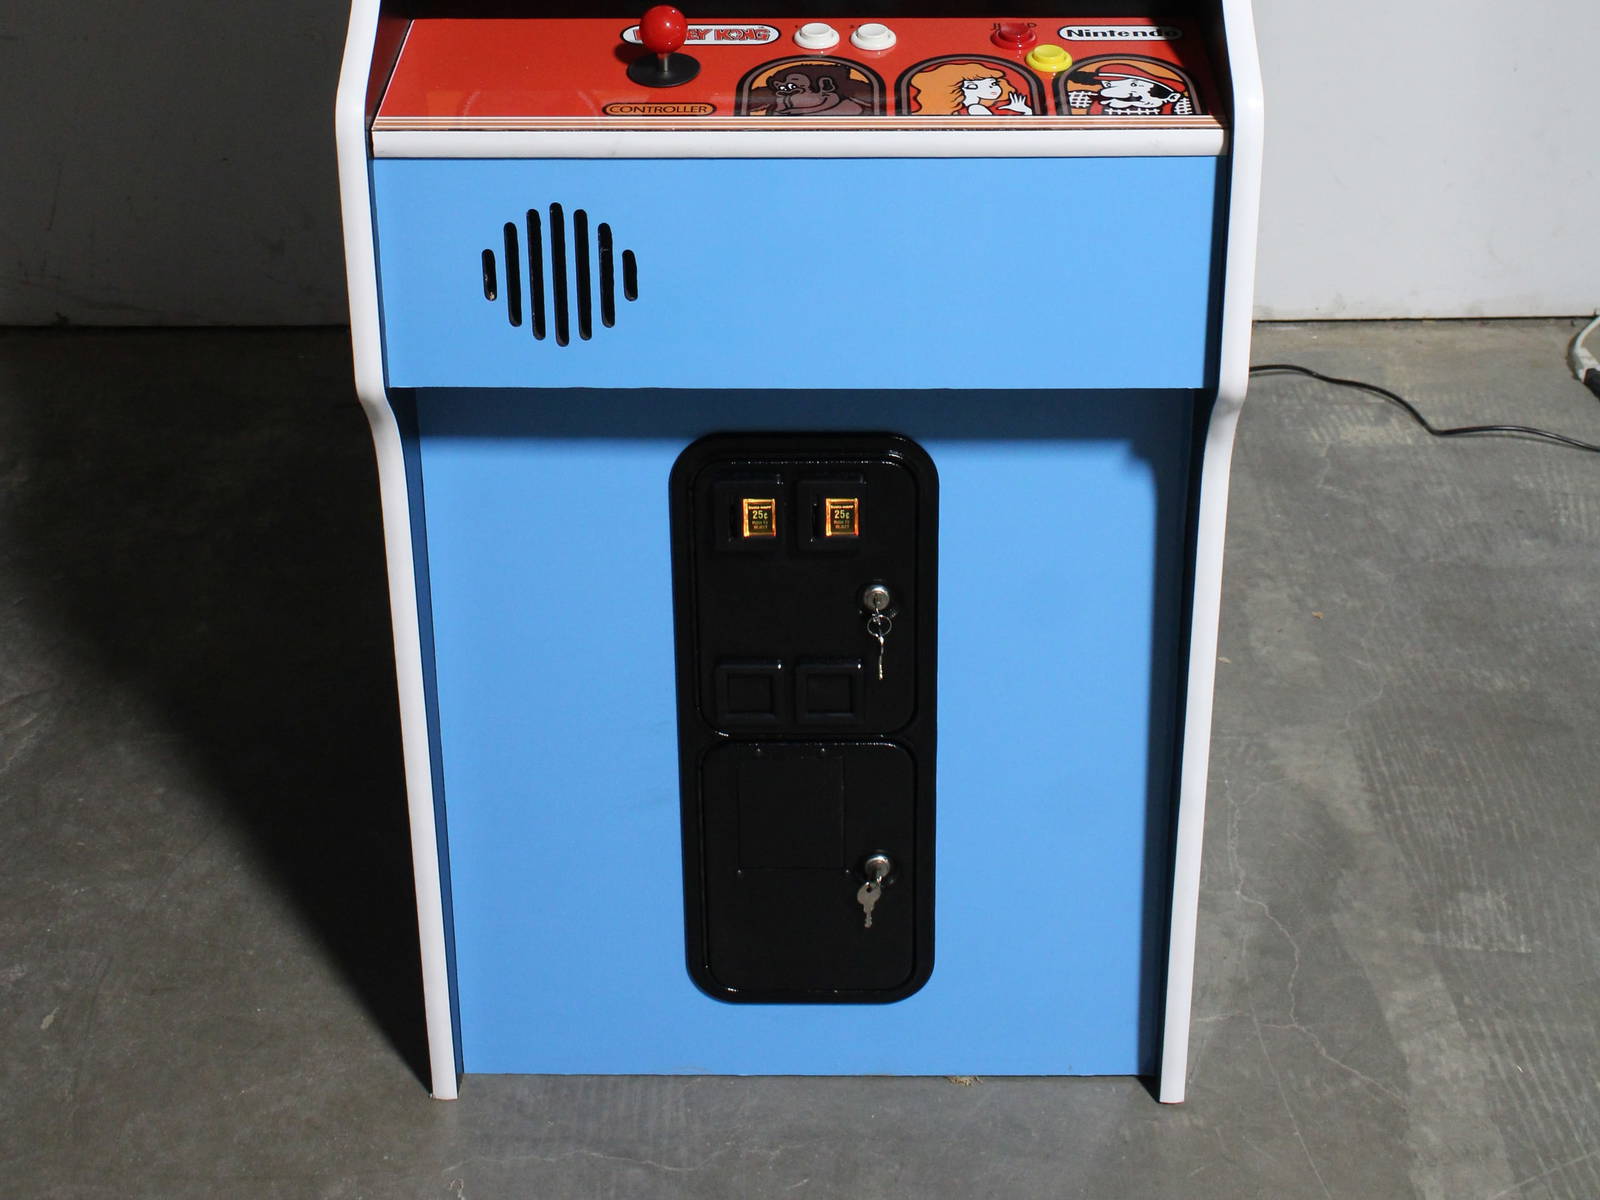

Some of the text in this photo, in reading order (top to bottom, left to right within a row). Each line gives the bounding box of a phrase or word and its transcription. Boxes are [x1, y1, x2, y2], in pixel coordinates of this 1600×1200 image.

[713, 28, 772, 41] KONG
[1066, 28, 1179, 38] Nintendo
[609, 105, 707, 113] CONTROLLER
